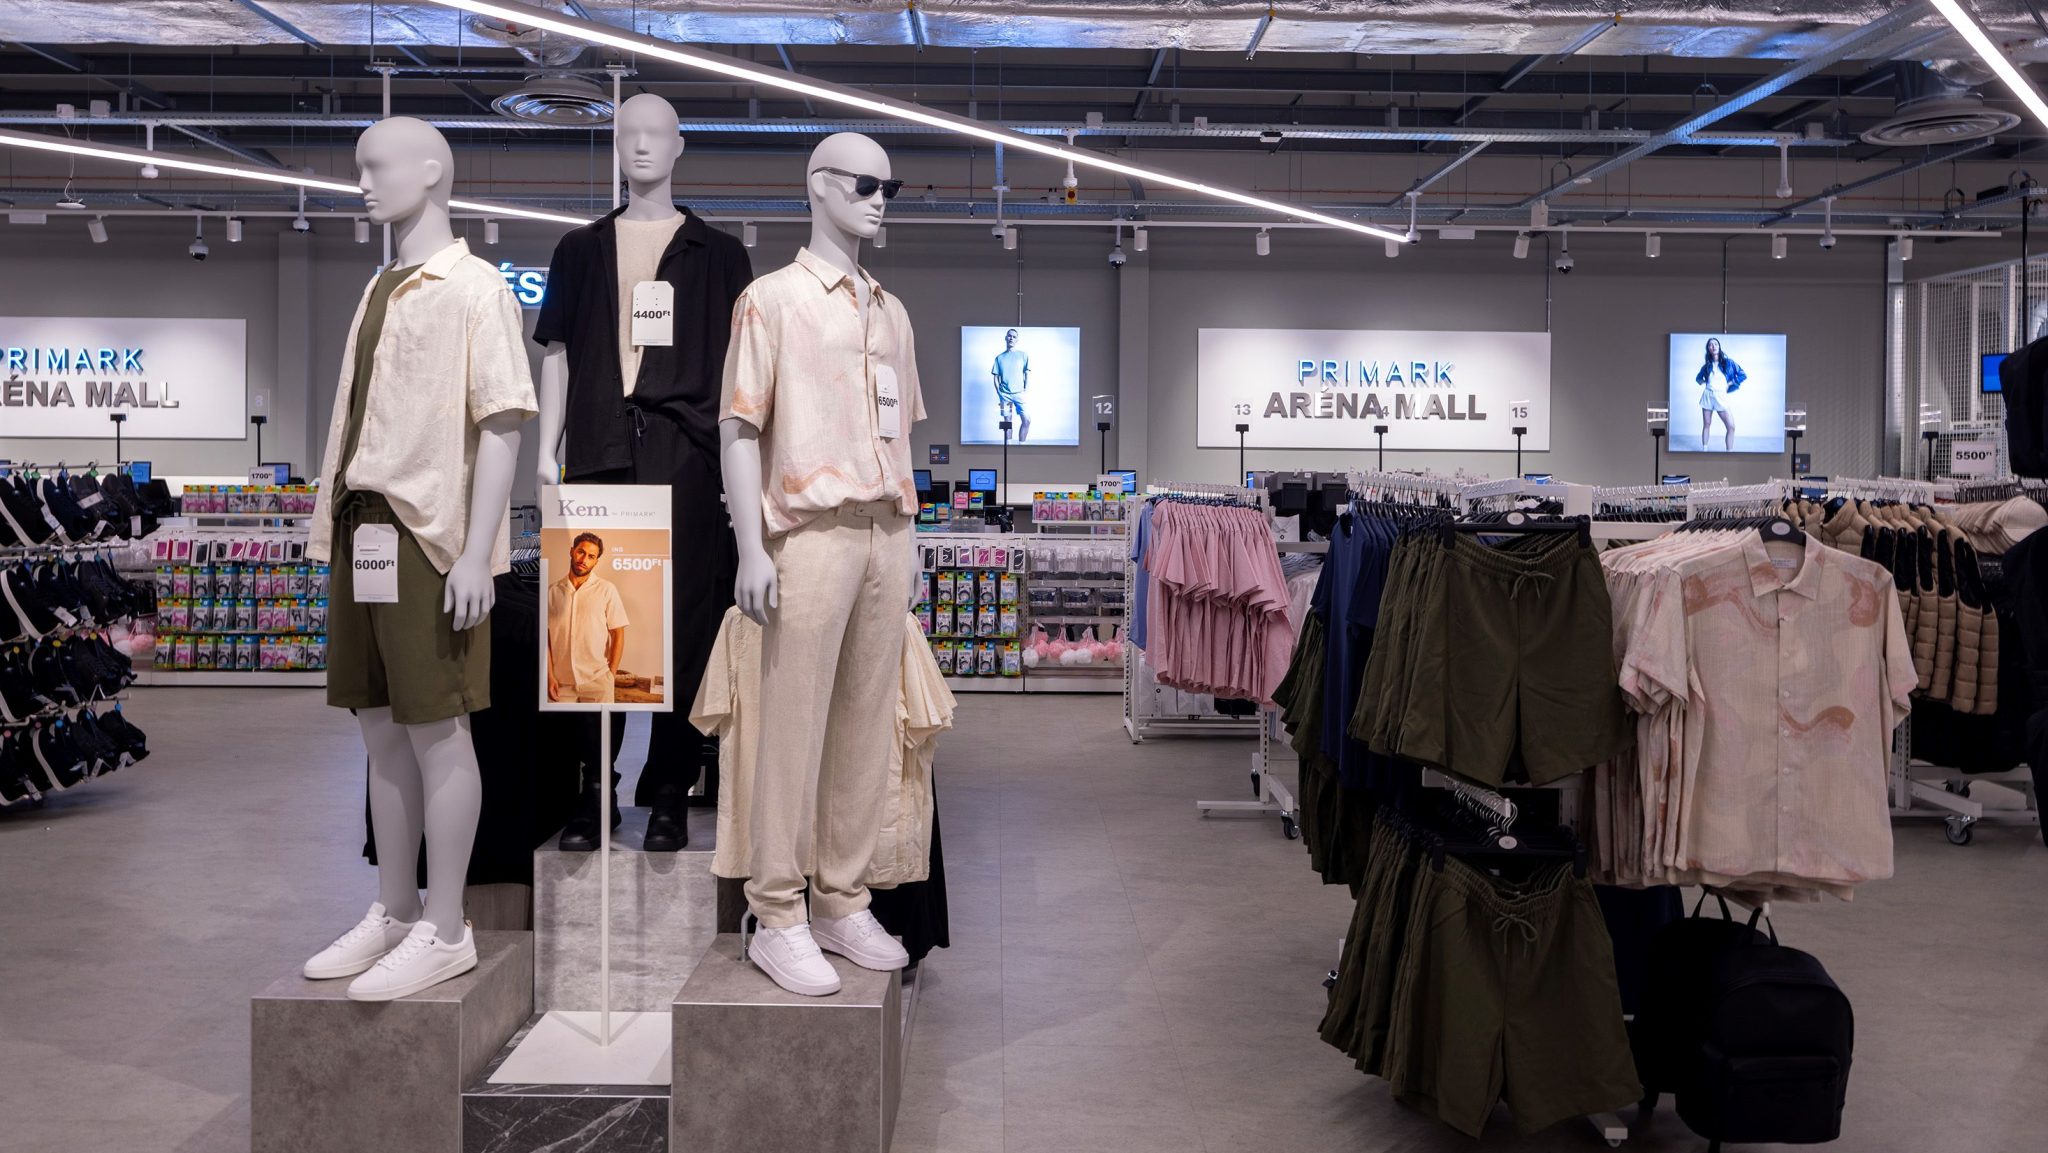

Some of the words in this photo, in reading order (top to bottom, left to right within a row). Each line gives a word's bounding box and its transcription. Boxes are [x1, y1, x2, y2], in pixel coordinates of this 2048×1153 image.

[633, 310, 671, 319] 4400Ft
[0, 347, 144, 371] RIMARK
[1298, 359, 1454, 384] PRIMARK
[0, 374, 75, 408] ÉNA
[85, 381, 180, 408] MALL
[1095, 402, 1113, 414] 12
[1263, 385, 1383, 419] ARÉNA
[1395, 393, 1487, 420] MALL
[1234, 404, 1251, 416] 13
[1511, 407, 1528, 418] 15
[557, 499, 609, 517] Kem
[354, 559, 395, 570] 6000Ft
[612, 558, 662, 571] 6500Ft
